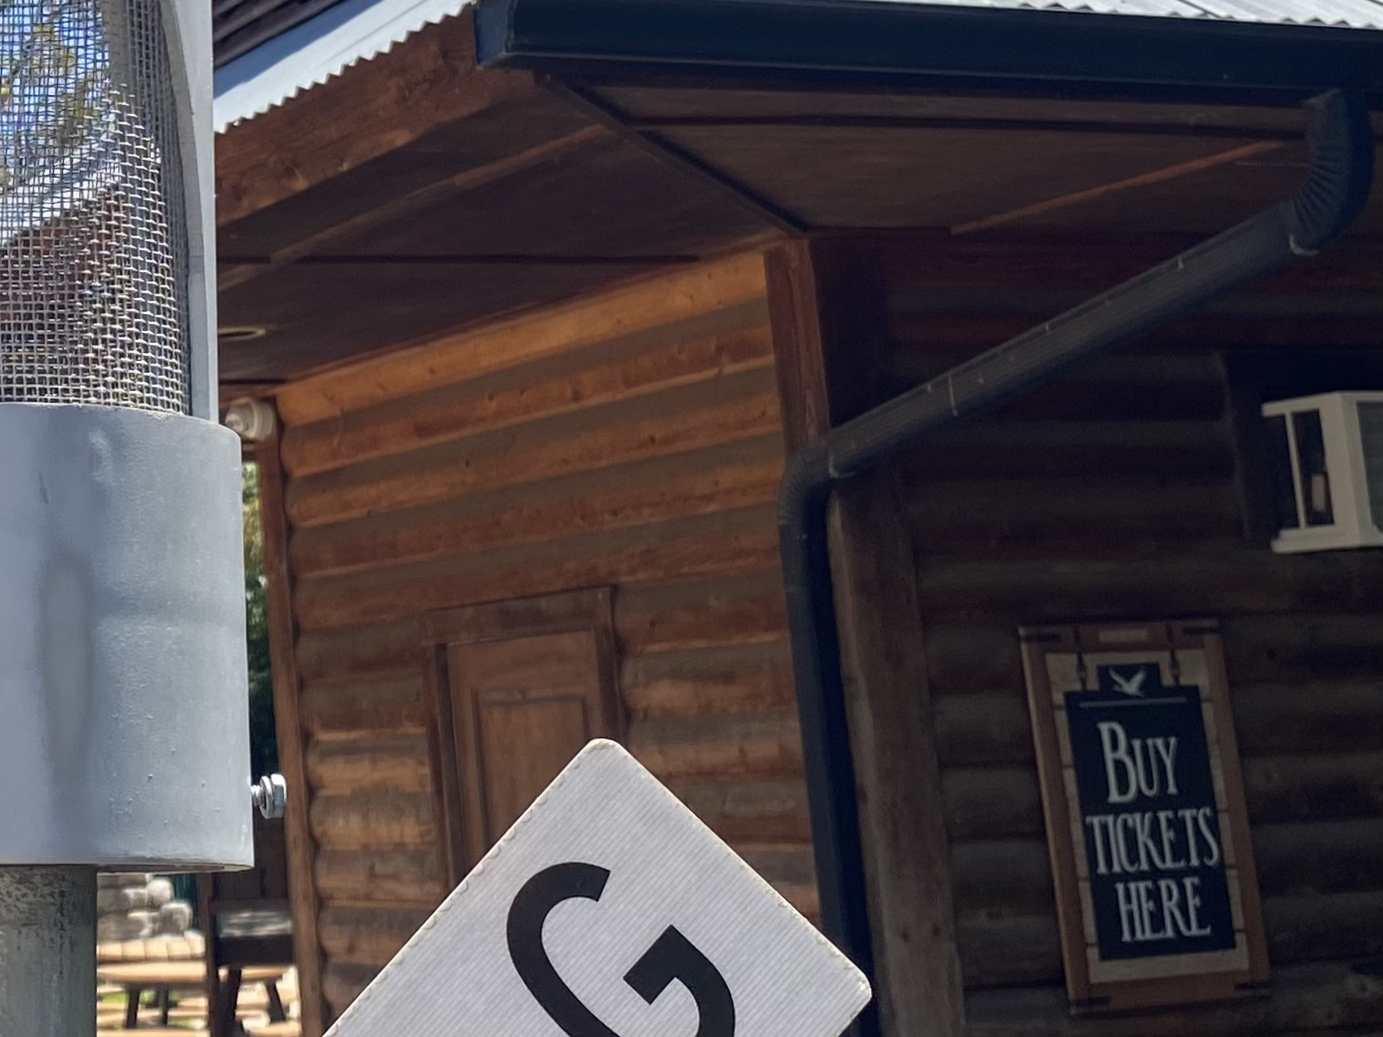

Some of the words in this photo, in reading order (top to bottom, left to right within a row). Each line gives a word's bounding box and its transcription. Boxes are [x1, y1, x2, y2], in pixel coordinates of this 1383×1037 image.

[1097, 721, 1178, 804] BUY
[1085, 806, 1221, 875] TICKETS
[1114, 877, 1212, 943] HERE
